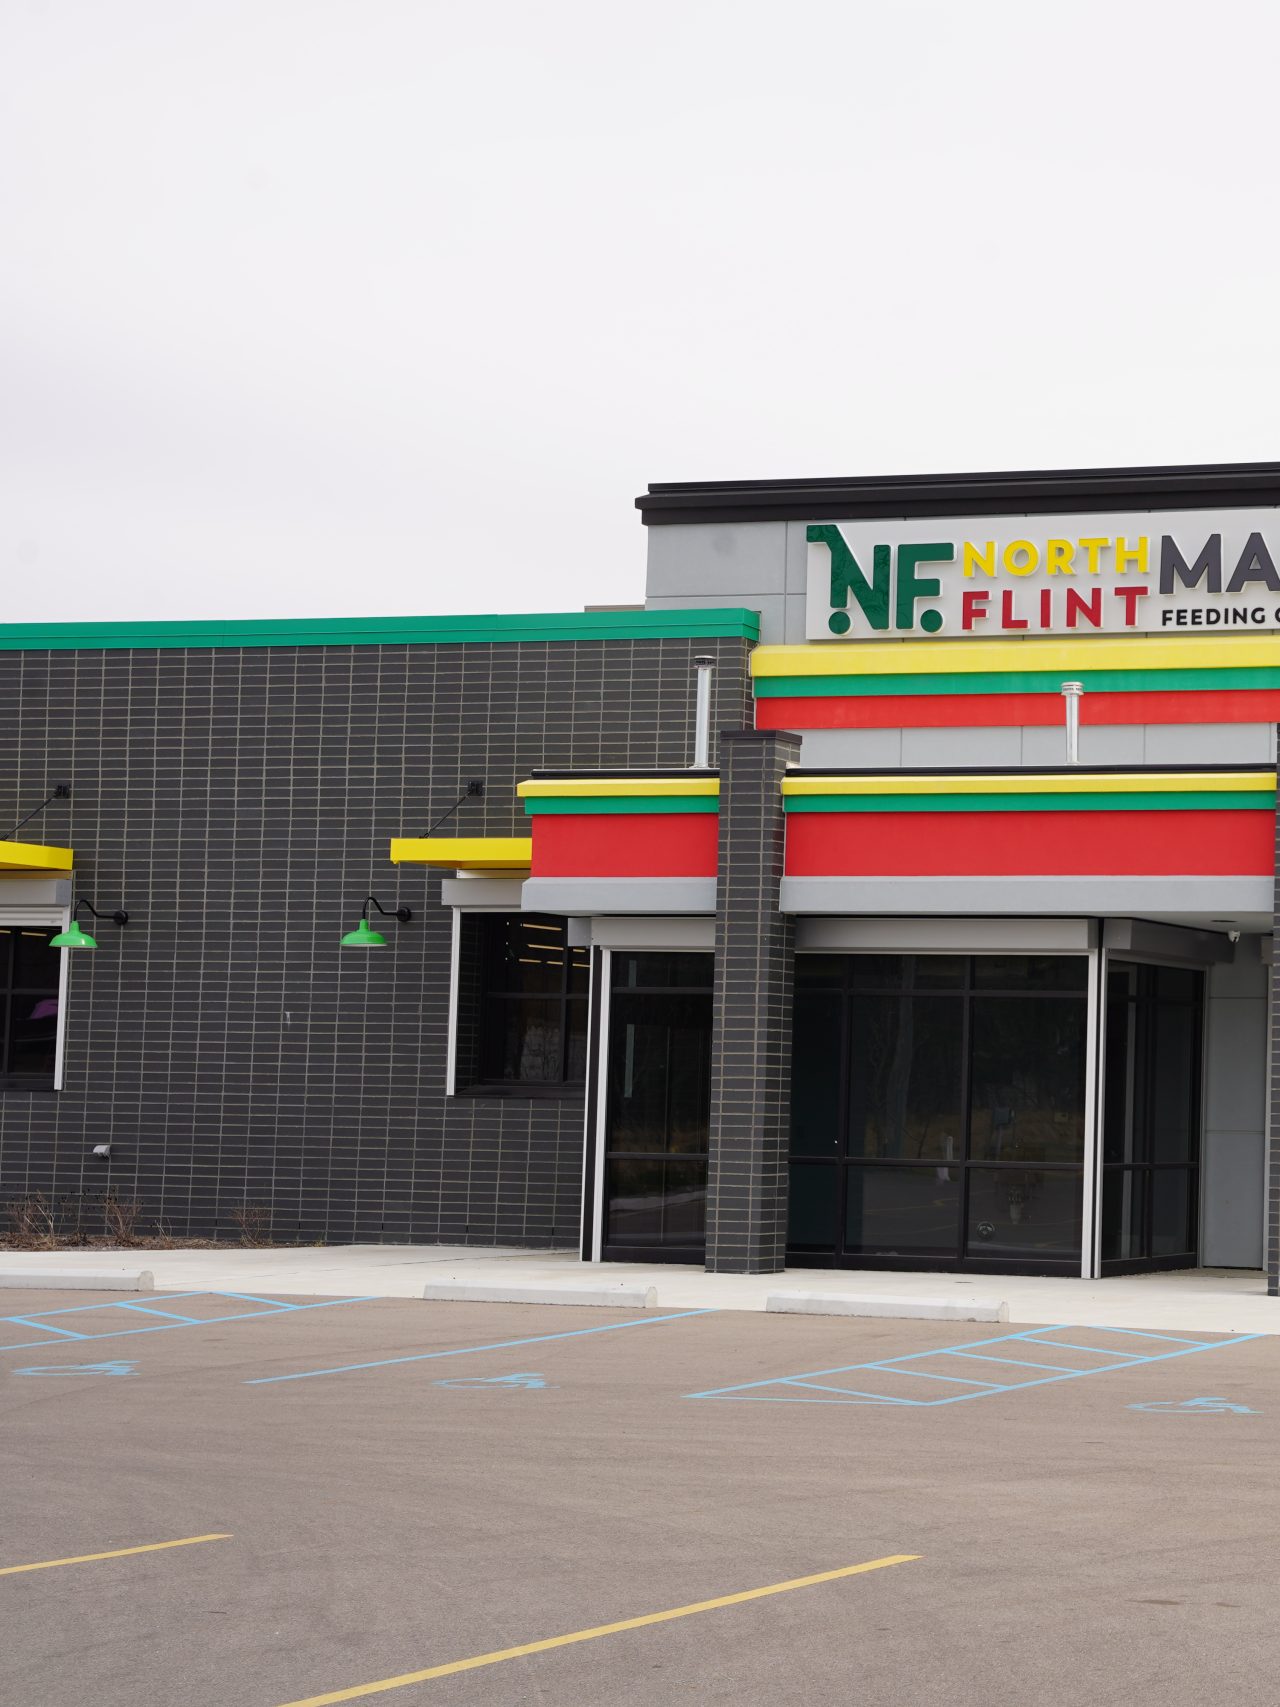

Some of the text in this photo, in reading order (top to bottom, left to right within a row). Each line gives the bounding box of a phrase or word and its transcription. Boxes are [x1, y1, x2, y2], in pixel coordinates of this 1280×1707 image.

[963, 536, 1149, 577] NORTH
[962, 586, 1149, 630] FLINT
[1162, 607, 1265, 626] FEEDING
